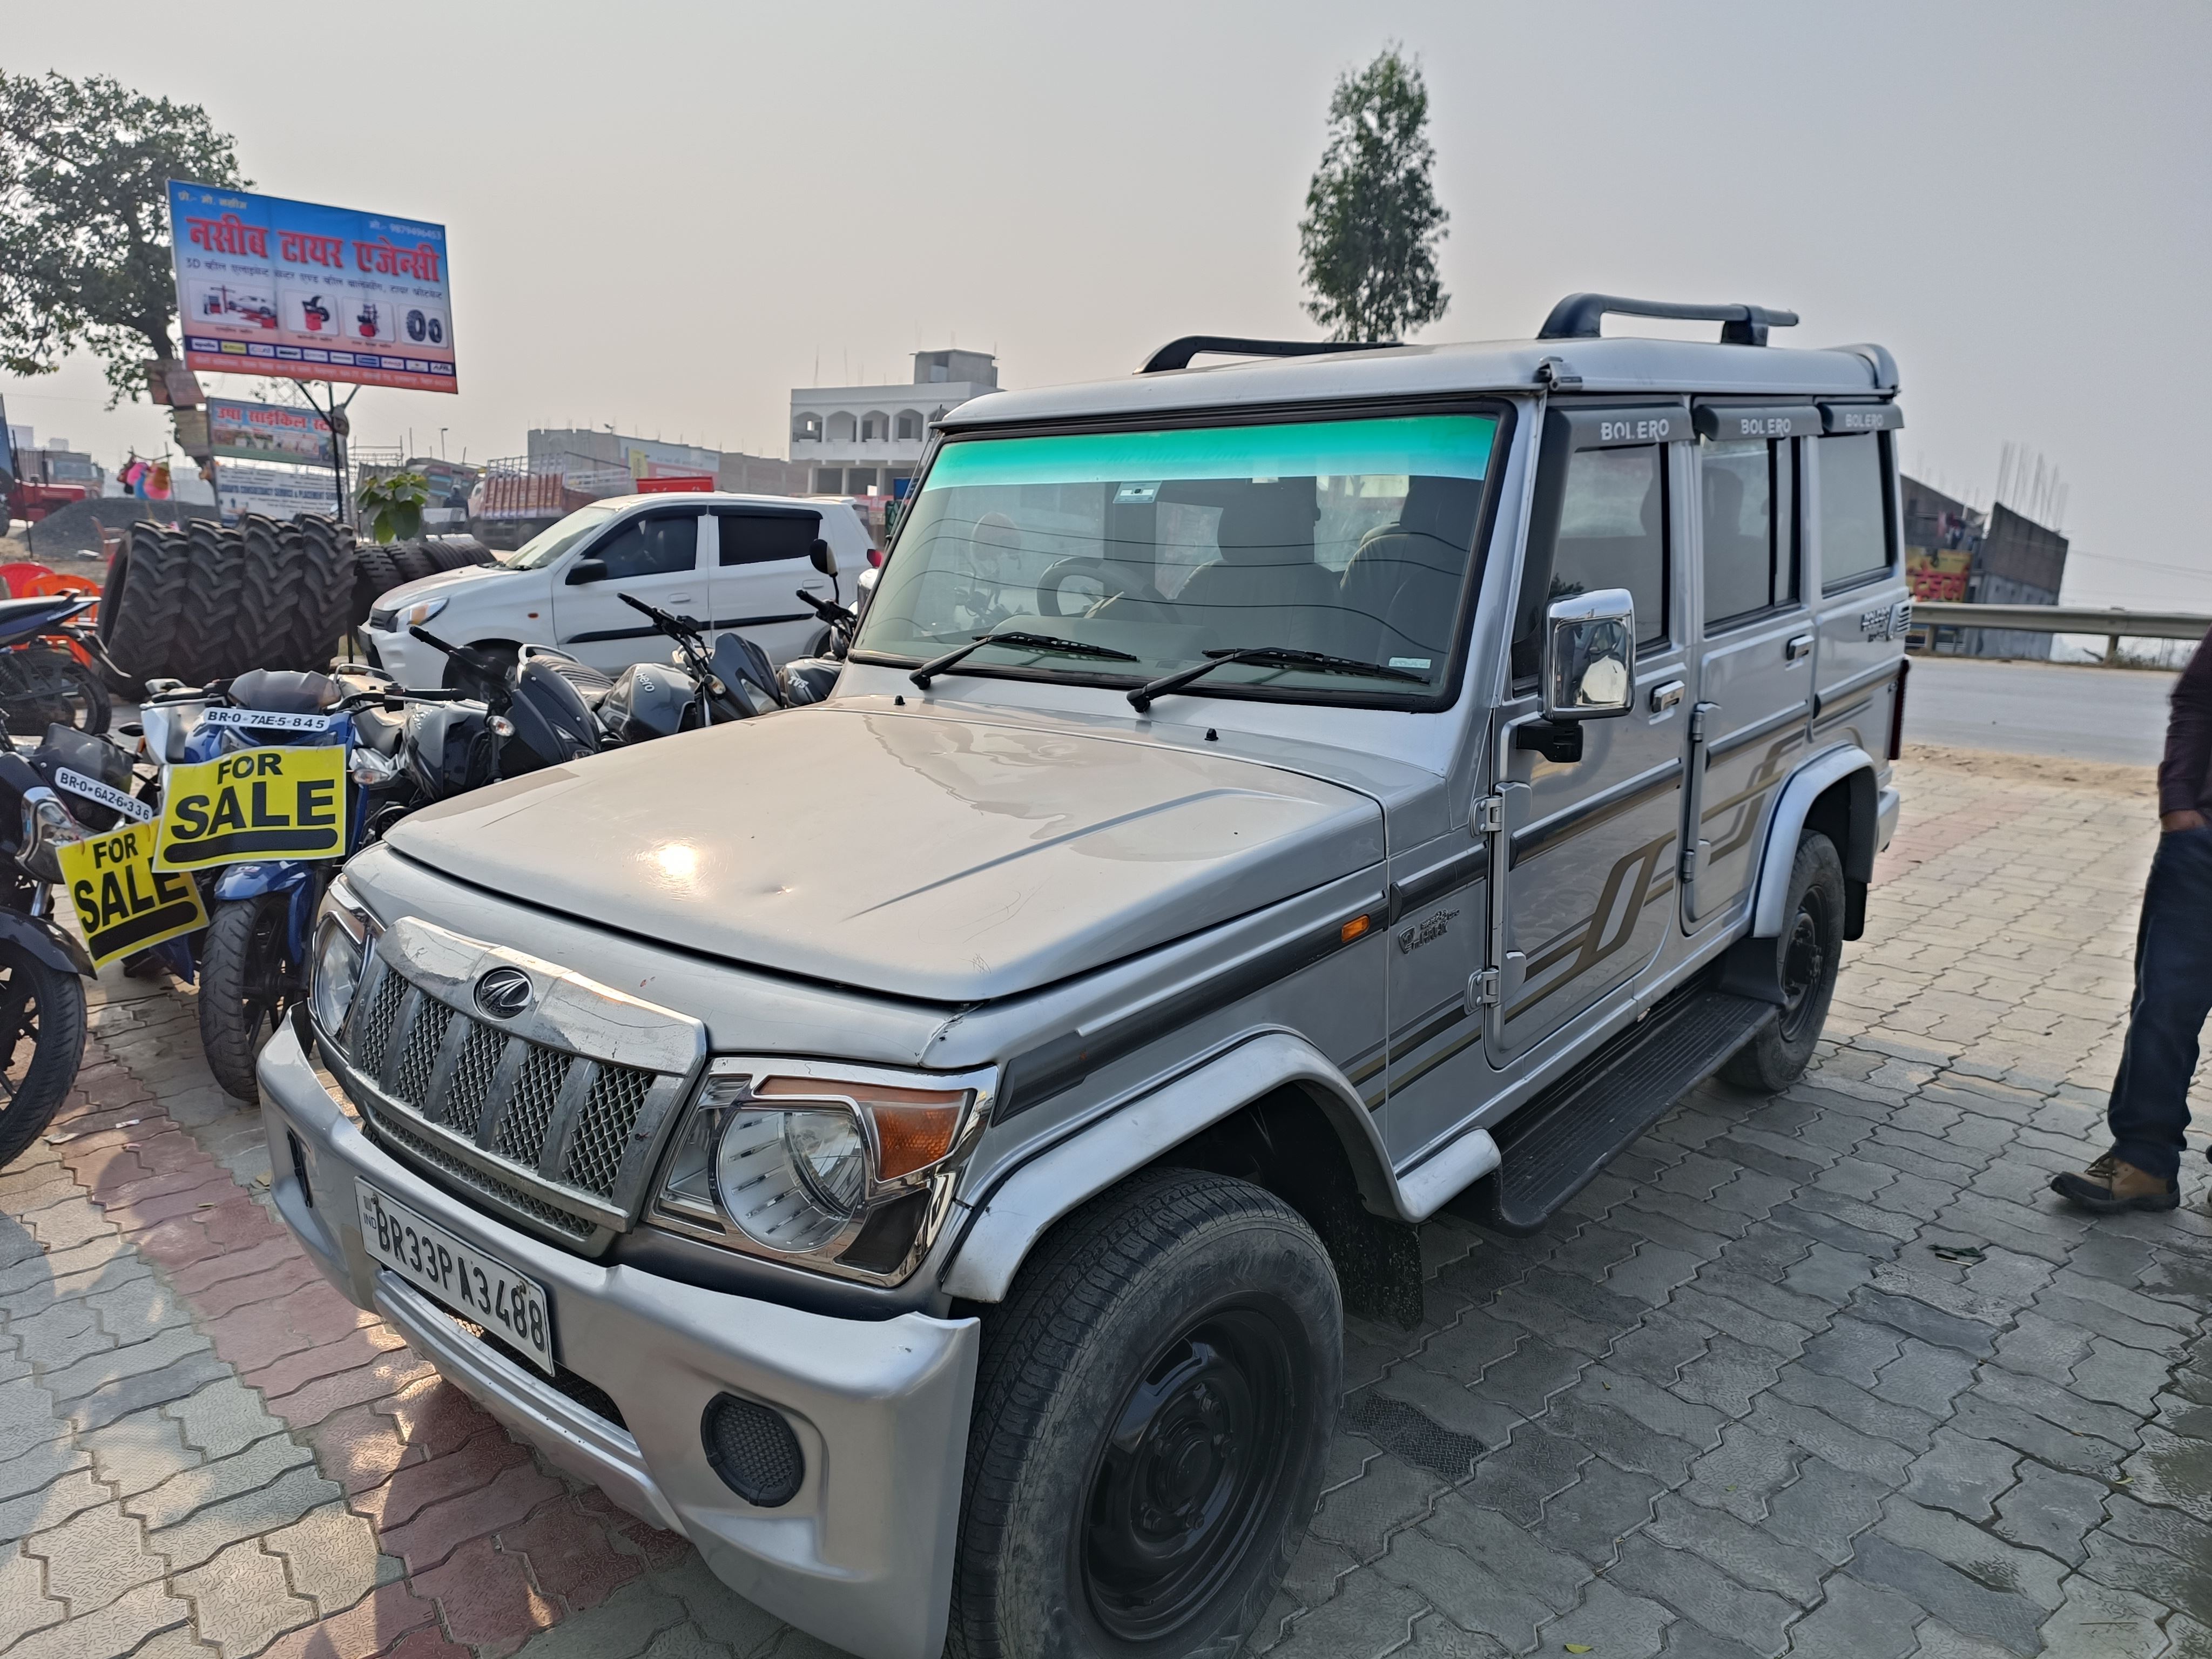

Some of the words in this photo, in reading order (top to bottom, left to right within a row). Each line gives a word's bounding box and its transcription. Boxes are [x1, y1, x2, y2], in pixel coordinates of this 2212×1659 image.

[186, 213, 269, 259] नसीब
[276, 230, 344, 268] टायर
[352, 235, 441, 282] एजेन्सी
[185, 257, 201, 269] 3D
[217, 406, 241, 420] उषा
[1845, 413, 1884, 429] BOLERO
[1600, 419, 1670, 443] BOLERO
[1741, 417, 1792, 437] BOLERO
[636, 672, 655, 692] Hero
[787, 676, 809, 689] TVS
[218, 753, 283, 785] FOR
[171, 779, 336, 839] SALE
[93, 833, 139, 869] FOR
[73, 858, 189, 933] SALE
[363, 1212, 377, 1230] IND
[375, 1204, 545, 1352] BR33PA3488
